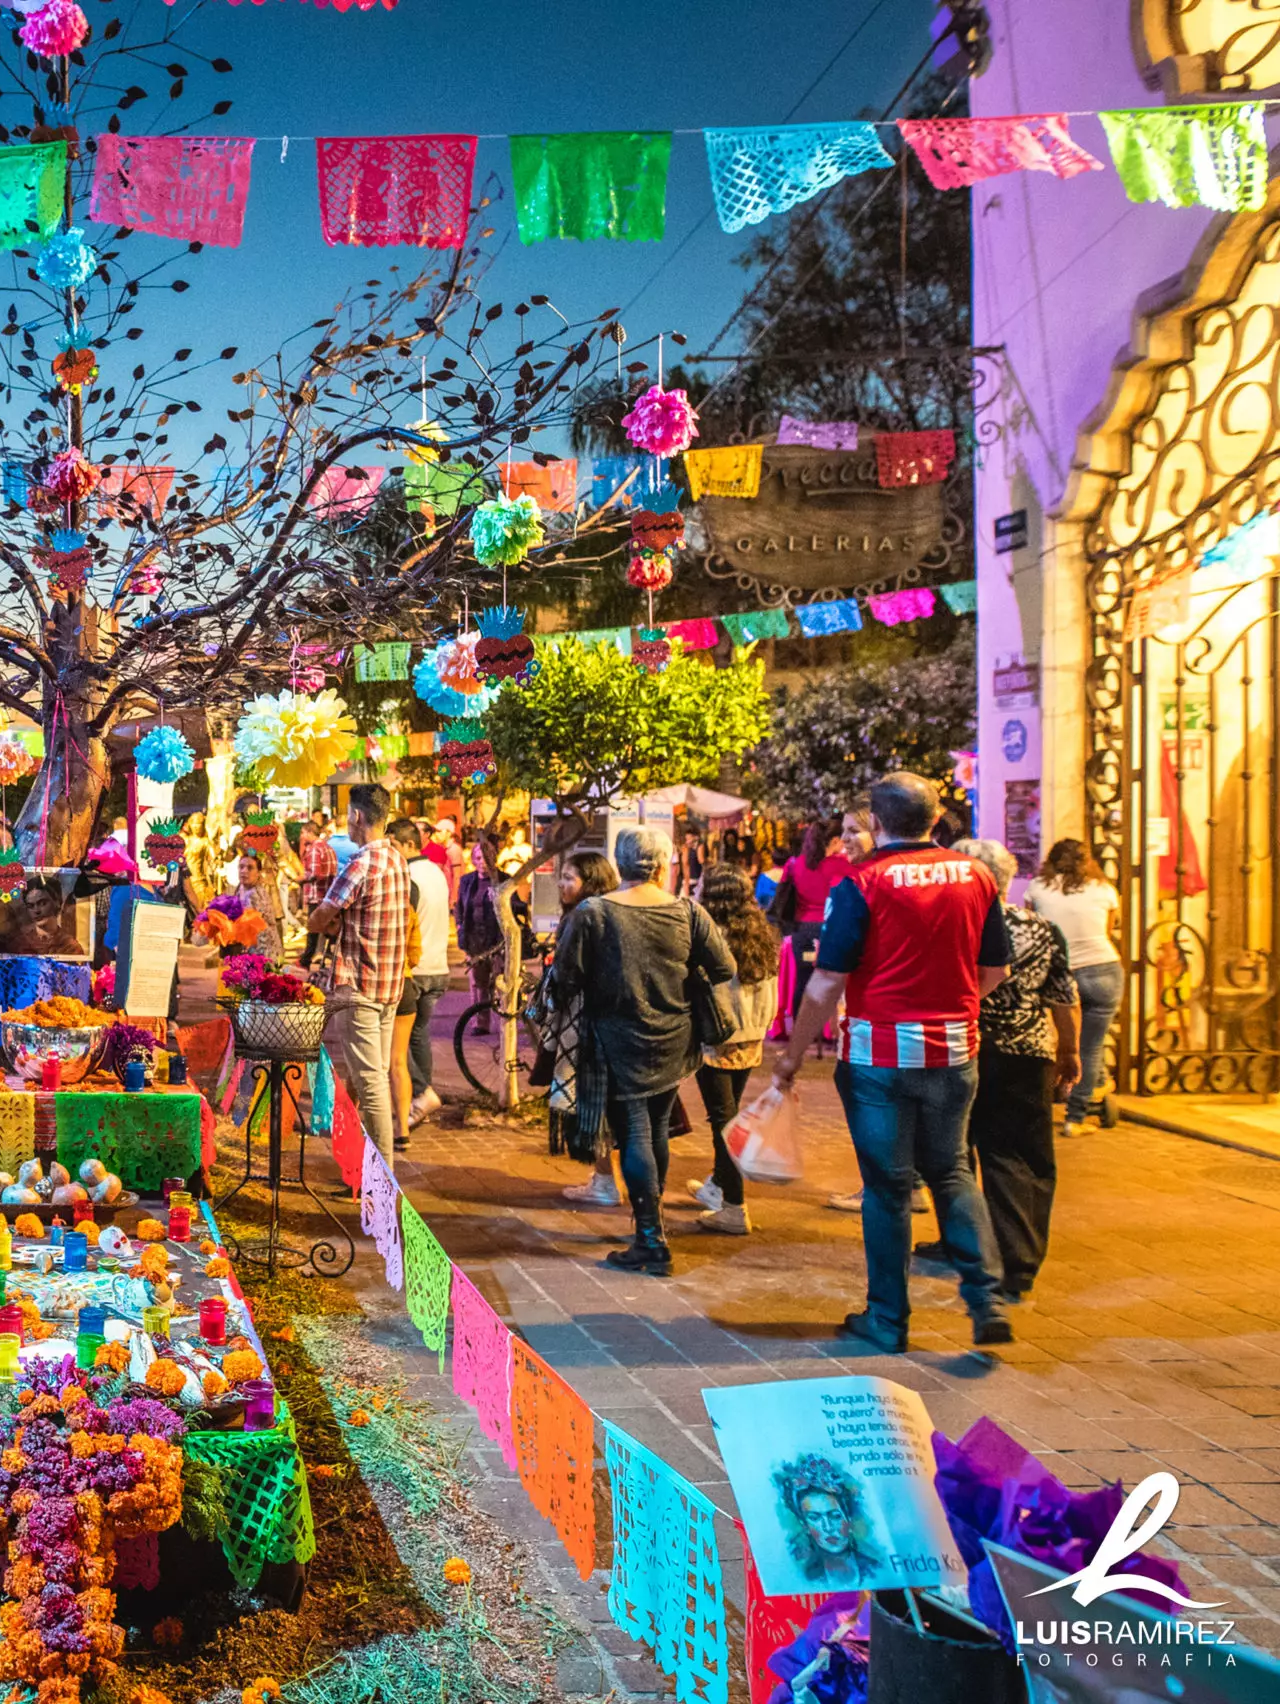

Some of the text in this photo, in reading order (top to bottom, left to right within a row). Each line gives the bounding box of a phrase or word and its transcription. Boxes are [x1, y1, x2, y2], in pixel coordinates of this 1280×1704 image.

[884, 860, 973, 888] TECATE
[878, 1409, 885, 1417] a
[827, 1426, 835, 1436] y
[837, 1423, 866, 1435] haya
[832, 1436, 874, 1448] besado
[877, 1437, 885, 1446] a
[863, 1465, 902, 1477] amado
[905, 1467, 912, 1475] a
[889, 1553, 940, 1573] Frida
